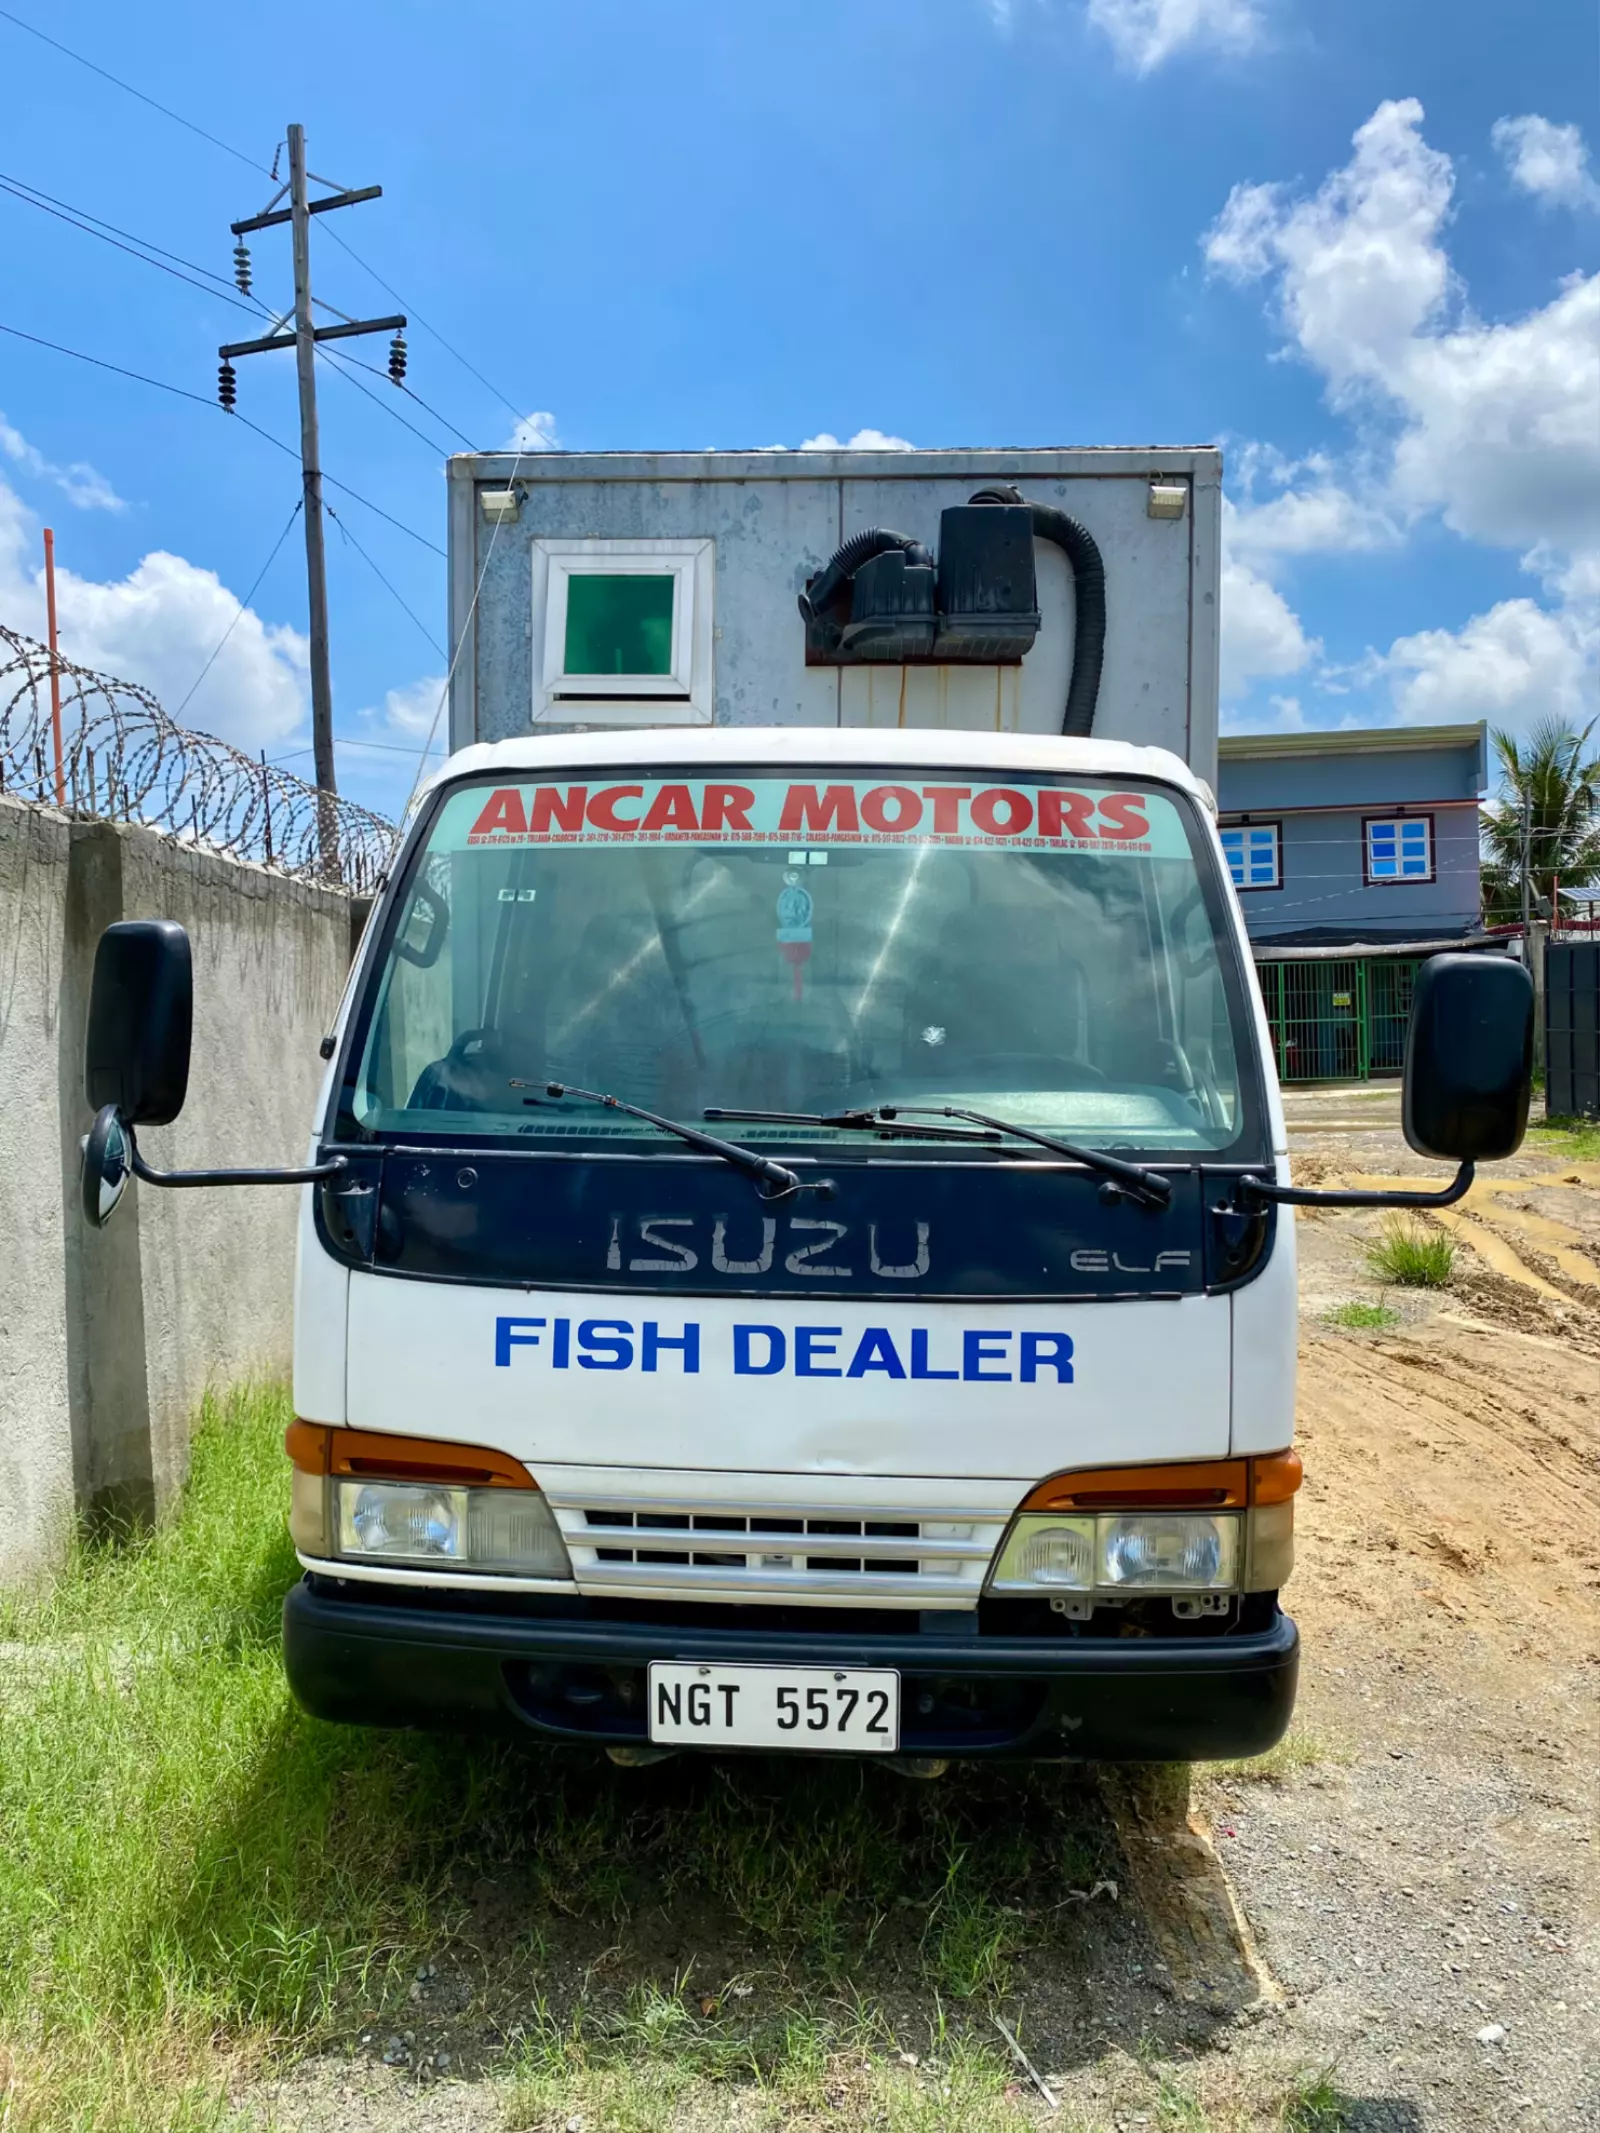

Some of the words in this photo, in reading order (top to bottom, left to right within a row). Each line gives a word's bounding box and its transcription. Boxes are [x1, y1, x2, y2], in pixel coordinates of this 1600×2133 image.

[469, 784, 756, 834] ANCAR
[778, 784, 1150, 840] MOTORS
[606, 1214, 931, 1278] ISUZU
[1070, 1250, 1191, 1272] ELF
[495, 1316, 700, 1374] FISH
[733, 1324, 1074, 1384] DEALER
[658, 1682, 740, 1728] NGT
[777, 1687, 889, 1733] 5572
